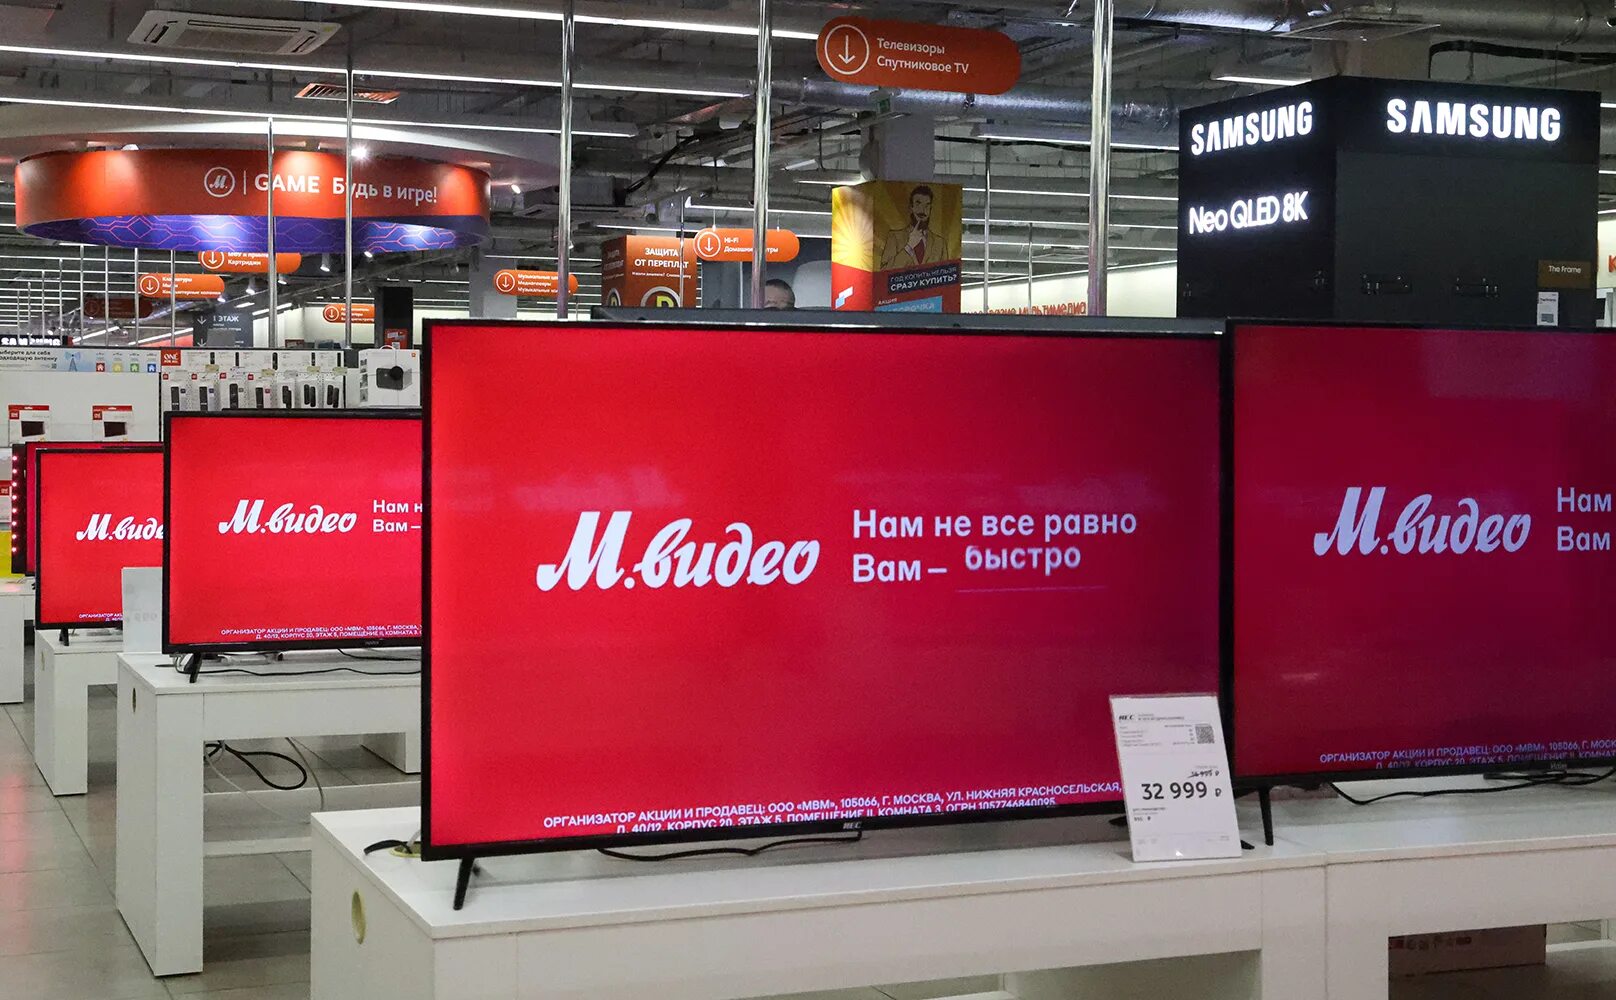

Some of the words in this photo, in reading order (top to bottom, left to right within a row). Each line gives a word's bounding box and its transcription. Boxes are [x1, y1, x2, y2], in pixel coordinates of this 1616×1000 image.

[877, 38, 945, 56] Телевизоры
[877, 55, 952, 71] Спутниковое
[954, 62, 969, 74] TV
[1191, 101, 1313, 156] SAMSUNG
[1387, 98, 1561, 142] SAMSUNG
[254, 173, 320, 194] GAME
[383, 185, 393, 197] в
[397, 187, 438, 207] игре!
[1189, 206, 1228, 235] Neo
[1229, 195, 1281, 229] QLED
[1282, 191, 1309, 222] 8K
[634, 259, 646, 267] ОТ
[645, 247, 679, 257] ЗАЩИТА
[890, 280, 919, 292] СРАЗУ
[919, 273, 958, 286] КУПИТЬ?
[1548, 265, 1560, 273] The
[1561, 265, 1582, 274] Frame
[372, 499, 409, 513] Нам
[414, 503, 423, 513] н
[1556, 487, 1612, 513] Нам
[75, 513, 164, 541] М.виде
[218, 499, 358, 534] М.видео
[372, 519, 408, 532] Вам
[852, 508, 924, 539] Нам
[933, 515, 972, 537] не
[981, 515, 1035, 536] все
[1044, 512, 1138, 543] равно
[1313, 486, 1532, 556] М.видео
[535, 510, 820, 592] М.видео
[1556, 526, 1611, 551] Вам
[852, 552, 922, 583] Вам
[964, 545, 1082, 577] быстро
[1319, 750, 1391, 763] ОРГАНИЗАТОР
[1392, 748, 1426, 760] АКЦИИ
[1427, 748, 1435, 758] И
[1492, 745, 1513, 754] ООО
[1590, 739, 1616, 749] МОСК
[1579, 750, 1616, 760] КОМНАТ
[1141, 783, 1164, 801] 32
[1169, 781, 1208, 799] 999
[543, 811, 636, 829] ОРГАНИЗАТОР
[637, 808, 682, 822] АКЦИИ
[684, 807, 694, 818] И
[695, 803, 766, 817] ПРОДАВЕЦ:
[767, 801, 795, 813] ООО
[796, 799, 838, 811] «МВМ»,
[840, 797, 880, 808] 105066,
[882, 796, 891, 806] Г.
[893, 792, 944, 805] МОСКВА,
[946, 791, 964, 802] УЛ.
[966, 787, 1016, 800] НИЖНЯЯ
[1018, 781, 1122, 797] КРАСНОСЕЛЬСКАЯ,
[667, 818, 717, 831] КОРПУС
[738, 814, 773, 825] ЭТАЖ
[877, 804, 932, 817] КОМНАТА
[945, 802, 976, 812] ОГРН
